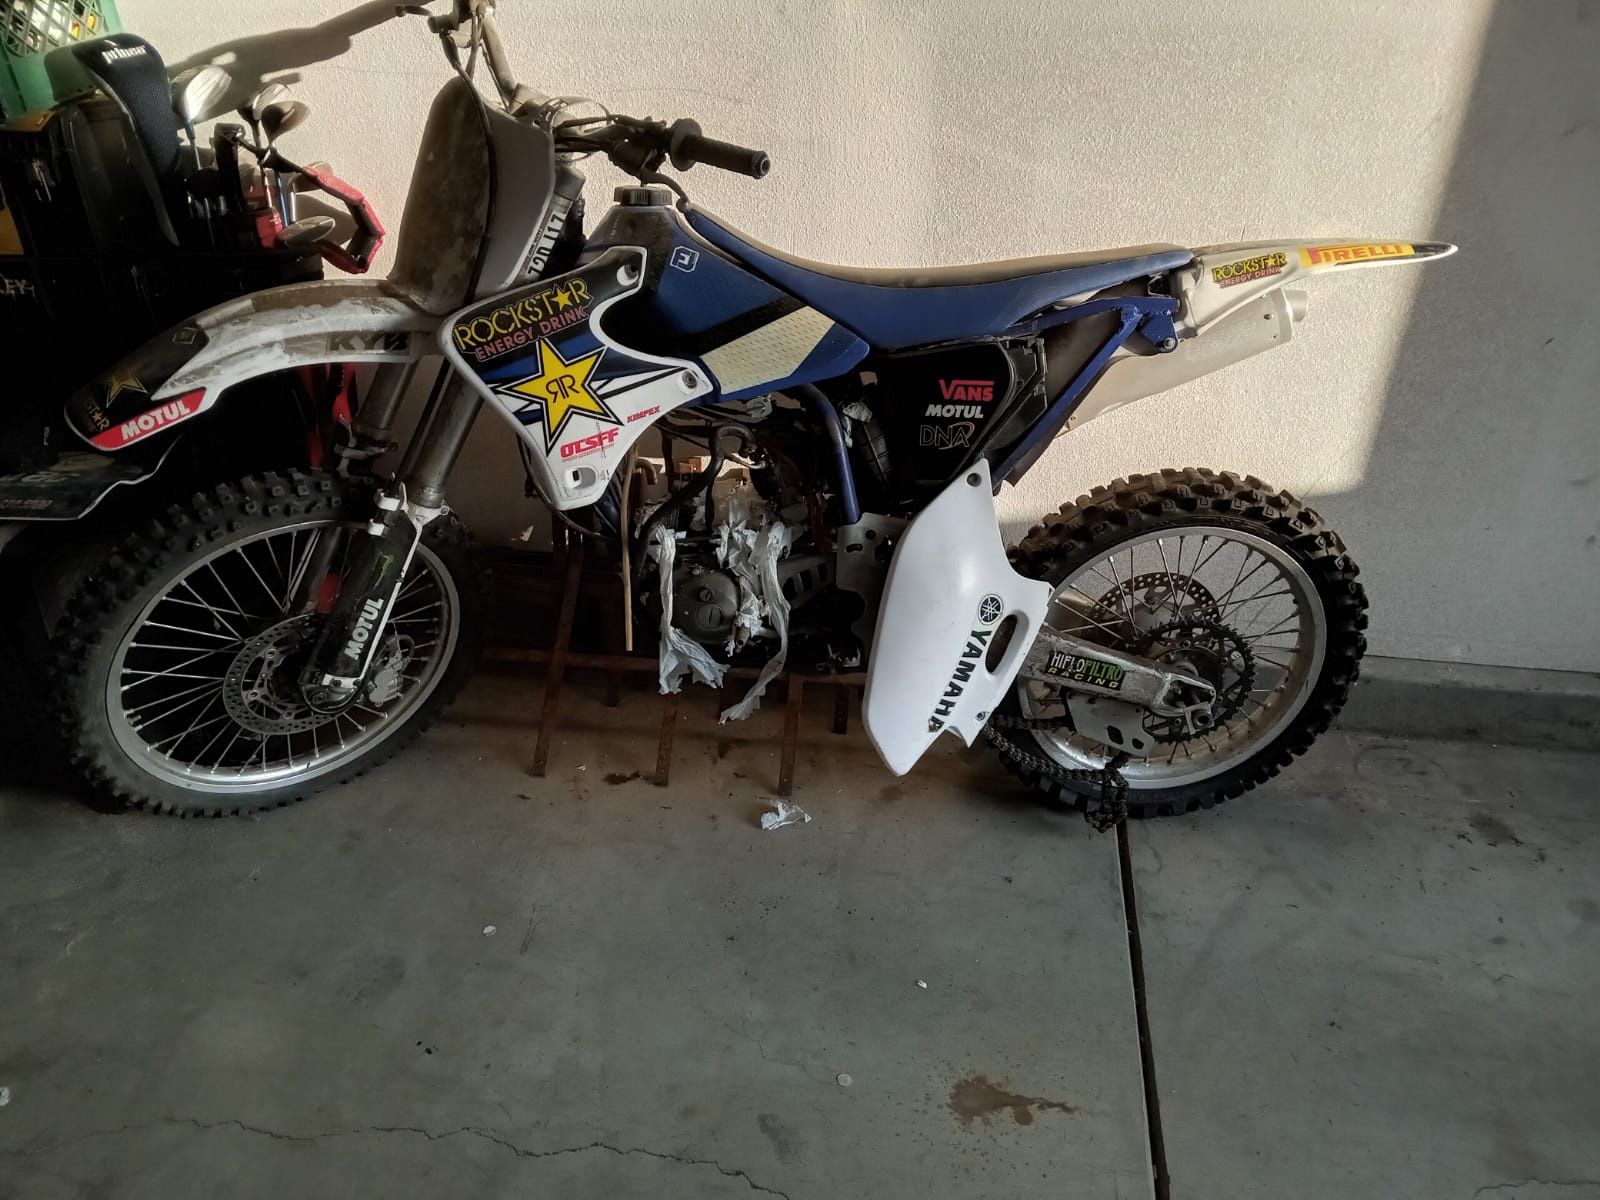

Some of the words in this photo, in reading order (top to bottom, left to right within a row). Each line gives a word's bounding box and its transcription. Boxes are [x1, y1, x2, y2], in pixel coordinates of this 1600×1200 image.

[1212, 252, 1288, 282] ROCKSTAR
[1307, 244, 1403, 265] PIRELLI
[1254, 265, 1282, 279] DRINK
[453, 278, 592, 352] ROCKSTAR
[474, 326, 535, 361] ENERGY
[539, 304, 588, 336] DRINK
[119, 399, 192, 442] MOTUL
[626, 404, 661, 424] KIMPEX
[924, 403, 985, 419] MOTUL
[919, 421, 976, 450] DNA
[343, 597, 385, 661] MOTUL
[927, 629, 993, 733] YAMAHA
[1046, 666, 1119, 689] RACING
